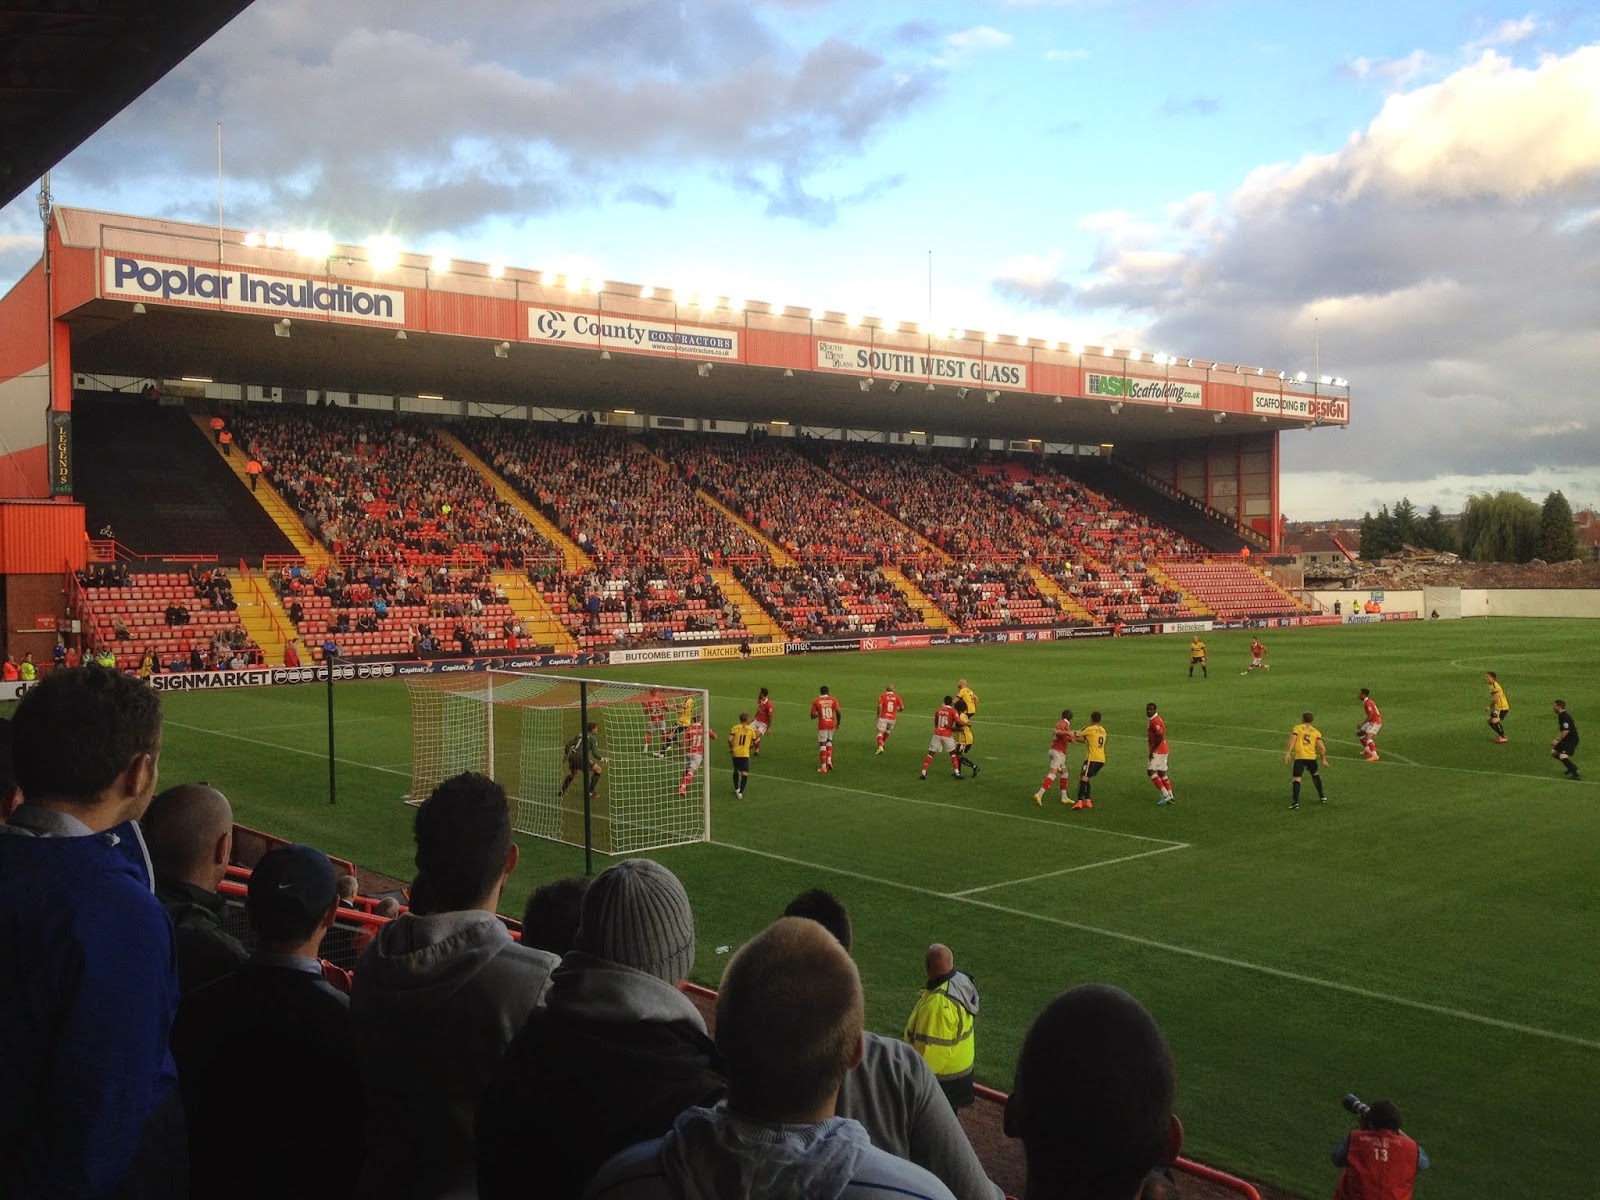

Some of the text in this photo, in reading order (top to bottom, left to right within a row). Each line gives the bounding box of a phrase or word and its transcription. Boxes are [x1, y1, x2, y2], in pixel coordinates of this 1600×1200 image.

[114, 256, 393, 318] Poplar Insulation
[573, 315, 646, 345] County
[819, 342, 842, 351] SOUTH
[825, 351, 844, 359] WEST
[833, 360, 854, 368] GLASS
[857, 349, 1020, 385] SOUTH WEST GLASS
[1255, 397, 1345, 418] SCAFFODING BY DESIGN
[58, 427, 68, 484] LEGENDS
[1177, 623, 1205, 632] Heineken
[996, 632, 1022, 642] sky BET
[1026, 631, 1051, 640] sky BET
[750, 644, 783, 655] HATCHERS
[786, 642, 810, 654] pmgc
[863, 638, 877, 650] RSG
[625, 649, 699, 661] BUTCOMBE BITTER
[152, 670, 270, 691] SIGNMARKET
[822, 707, 833, 719] 10
[739, 735, 746, 746] 11
[1098, 736, 1104, 748] 9
[1302, 734, 1311, 746] 5
[1374, 1148, 1389, 1162] 13
